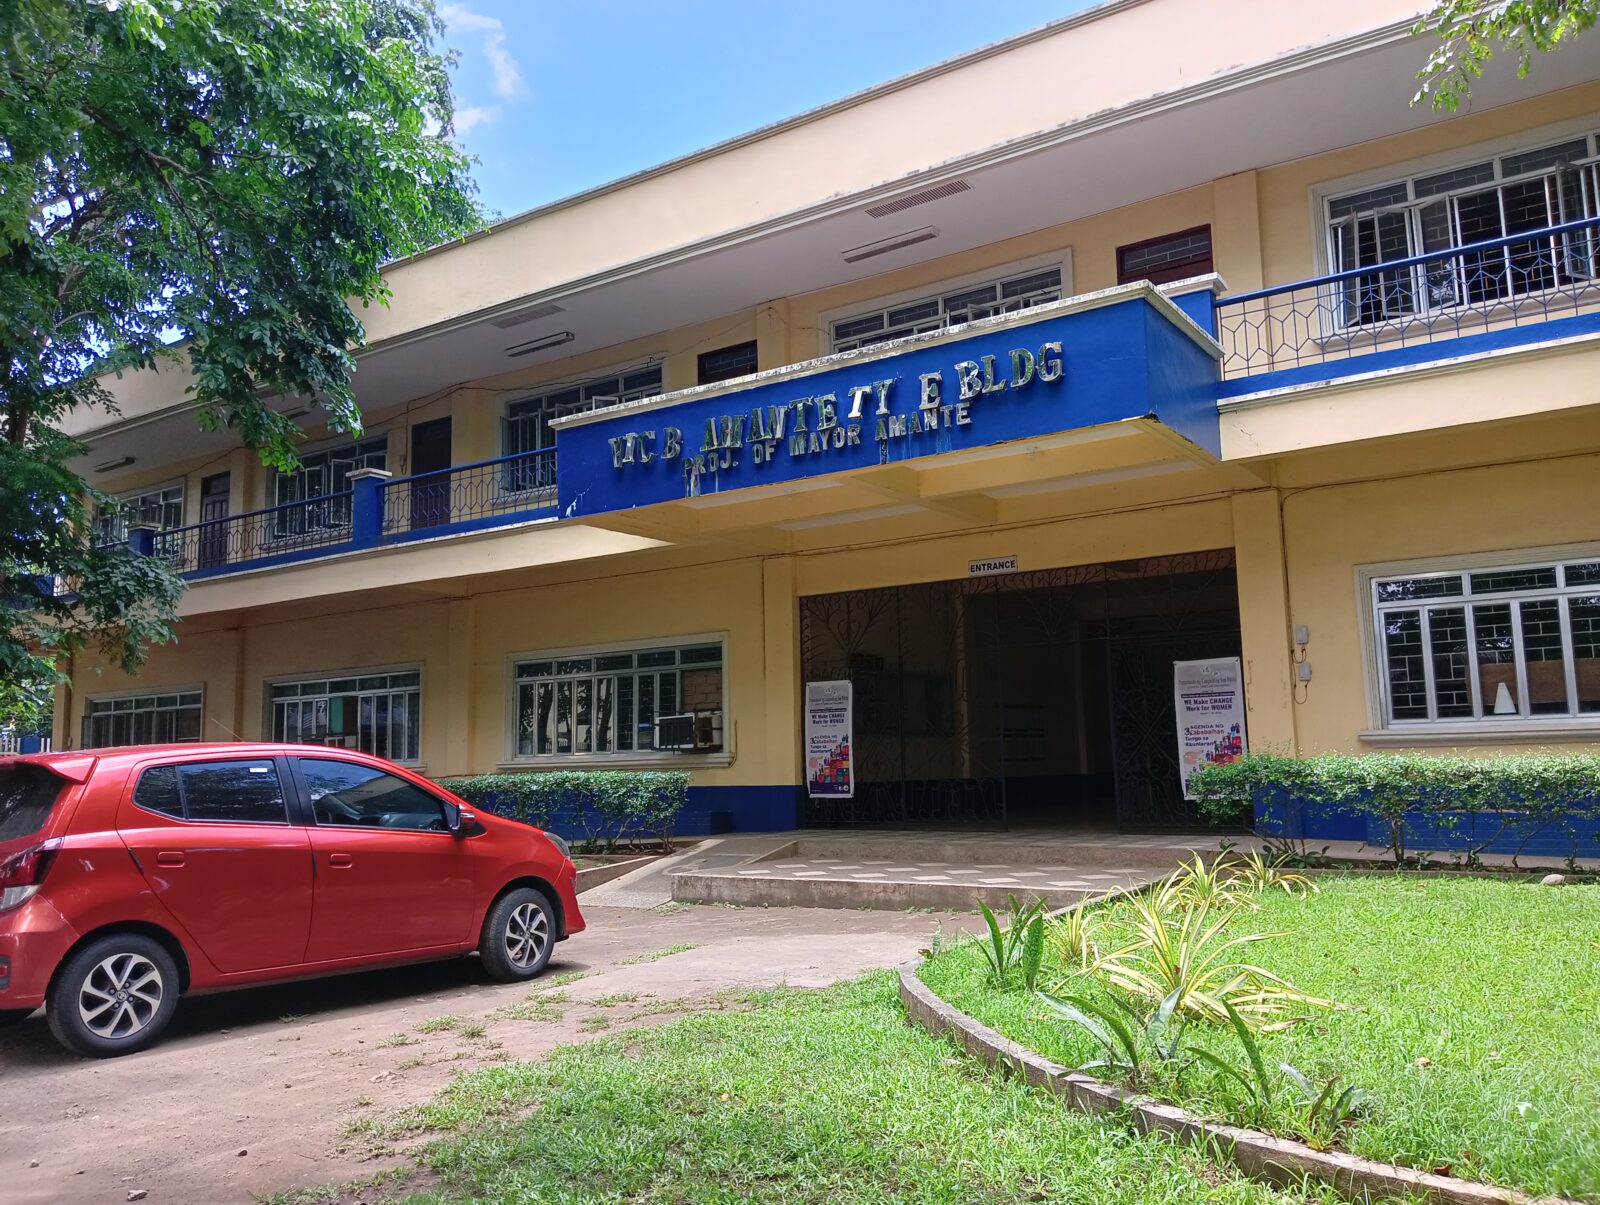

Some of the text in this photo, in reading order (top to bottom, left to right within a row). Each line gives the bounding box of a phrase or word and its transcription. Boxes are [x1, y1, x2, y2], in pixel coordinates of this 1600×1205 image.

[608, 430, 657, 468] VIC
[660, 426, 681, 459] B
[954, 341, 1063, 400] BLDG
[752, 439, 777, 464] OF
[789, 424, 861, 457] MAYOR
[875, 401, 972, 441] AMANTE
[970, 560, 1016, 572] ENTRANCE
